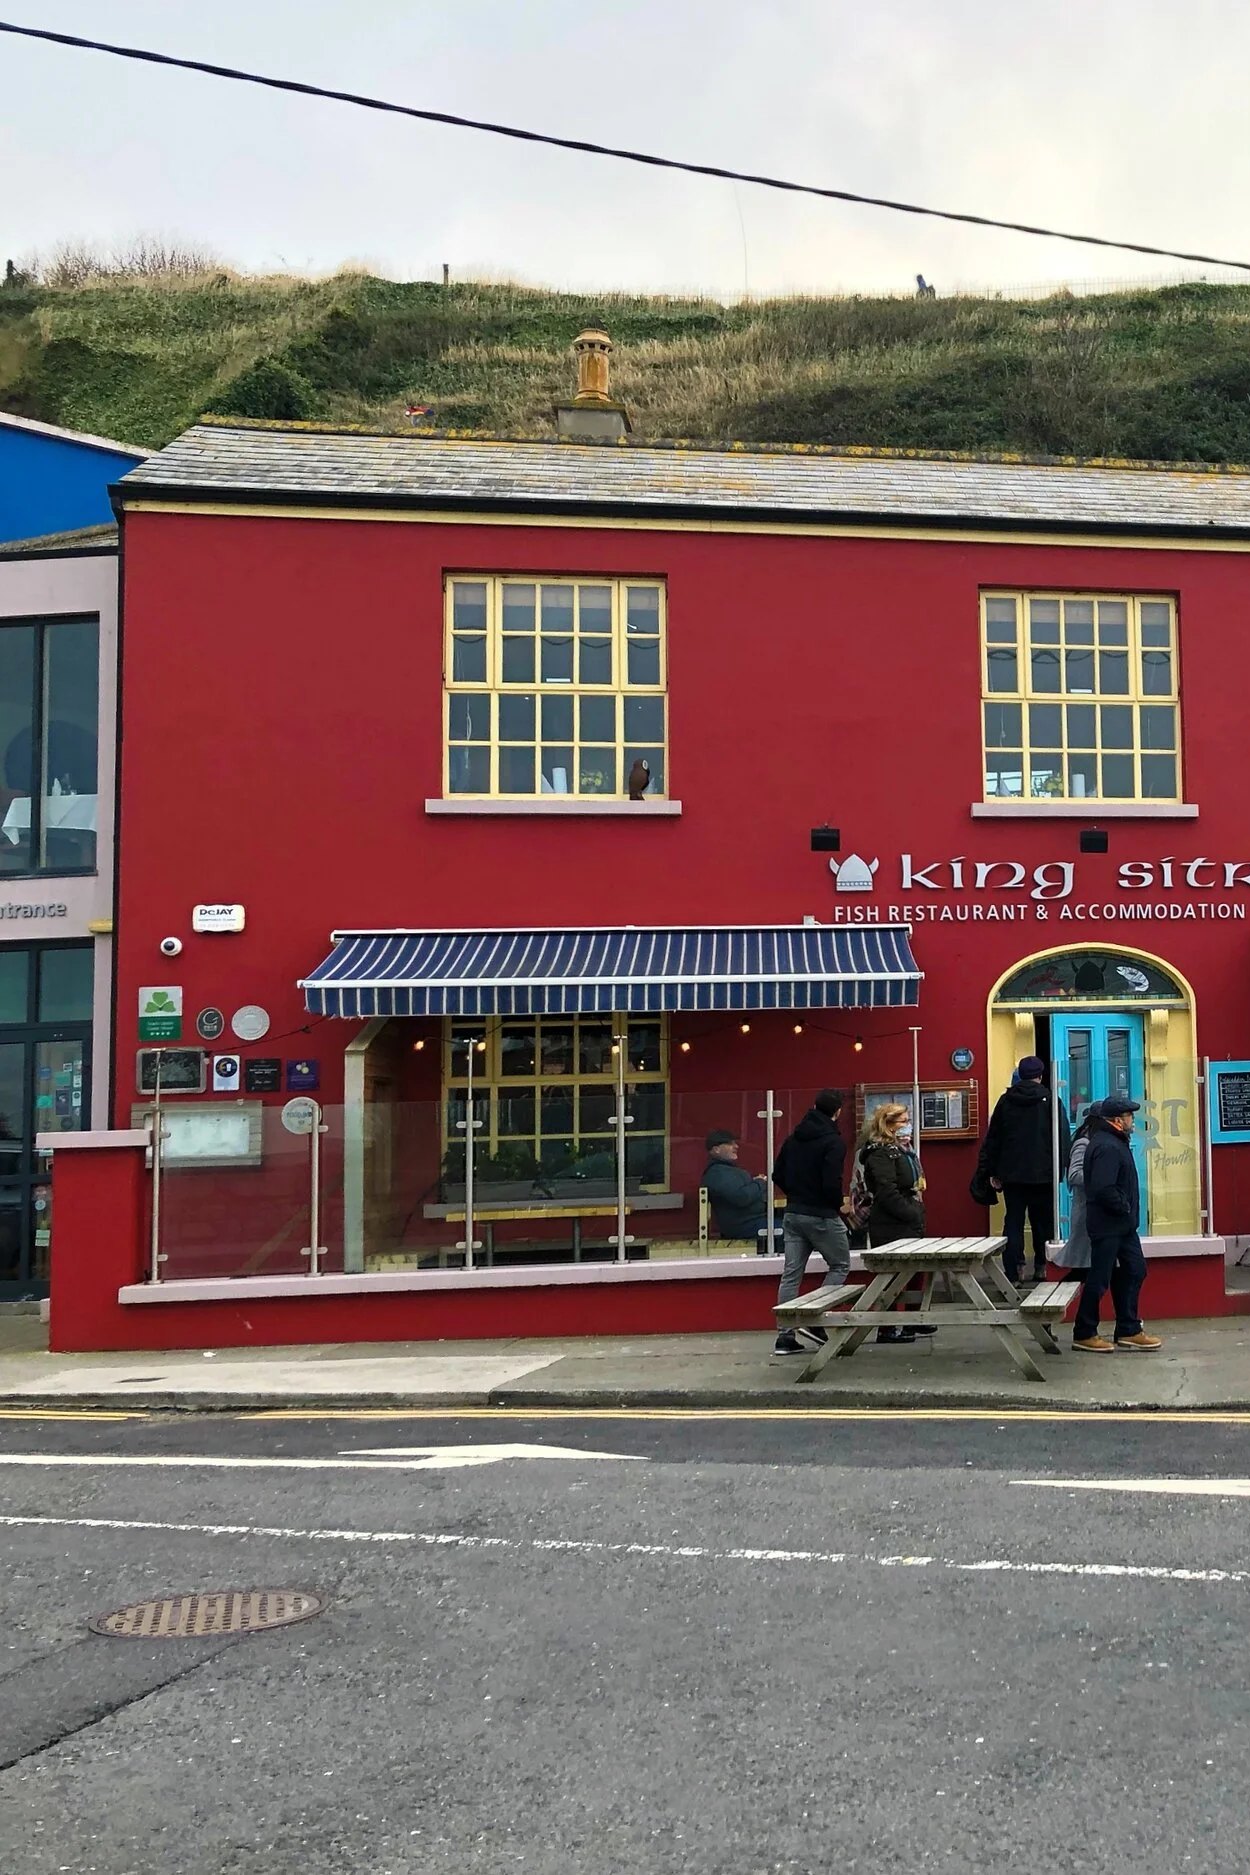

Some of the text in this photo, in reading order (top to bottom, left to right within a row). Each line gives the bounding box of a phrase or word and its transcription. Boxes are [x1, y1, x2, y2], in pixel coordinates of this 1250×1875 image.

[901, 853, 1075, 900] king
[834, 905, 880, 922] FISH
[888, 904, 1028, 921] RESTAURANT
[1036, 904, 1049, 920] &
[1060, 903, 1246, 920] ACCOMMODATION
